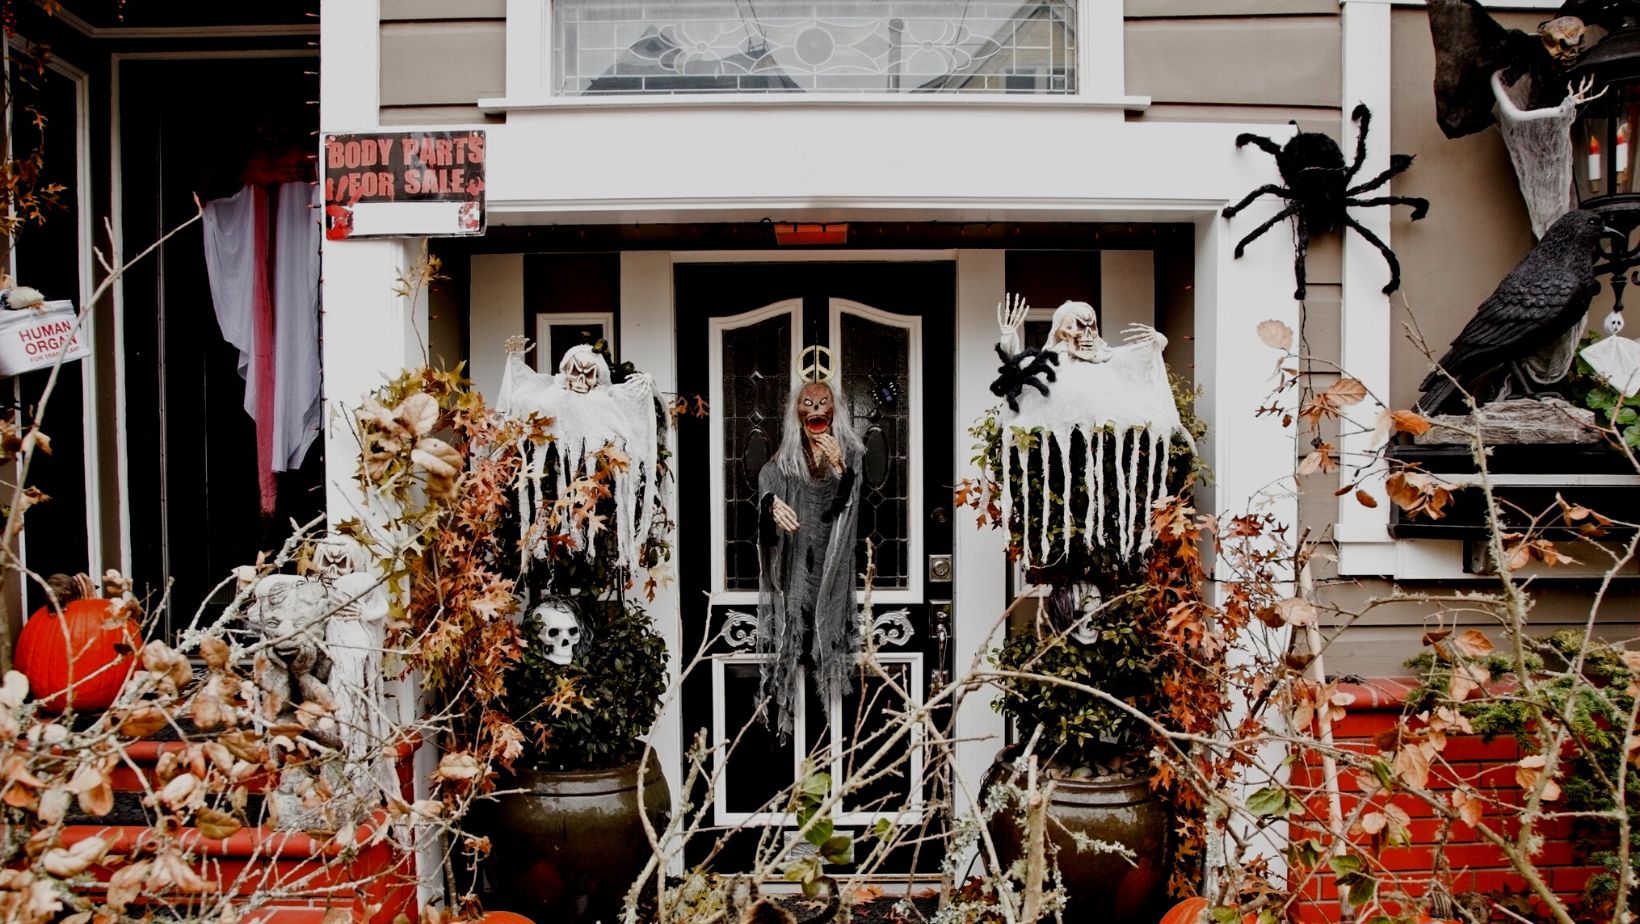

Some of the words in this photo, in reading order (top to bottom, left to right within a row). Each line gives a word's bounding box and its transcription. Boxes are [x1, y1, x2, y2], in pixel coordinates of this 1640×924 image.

[328, 139, 394, 169] BODY
[402, 136, 484, 166] PARTS
[348, 172, 394, 197] FOR
[404, 169, 465, 194] SALE
[18, 320, 71, 342] HUMAN
[30, 355, 43, 363] FOR
[44, 346, 80, 360] TRANLANT
